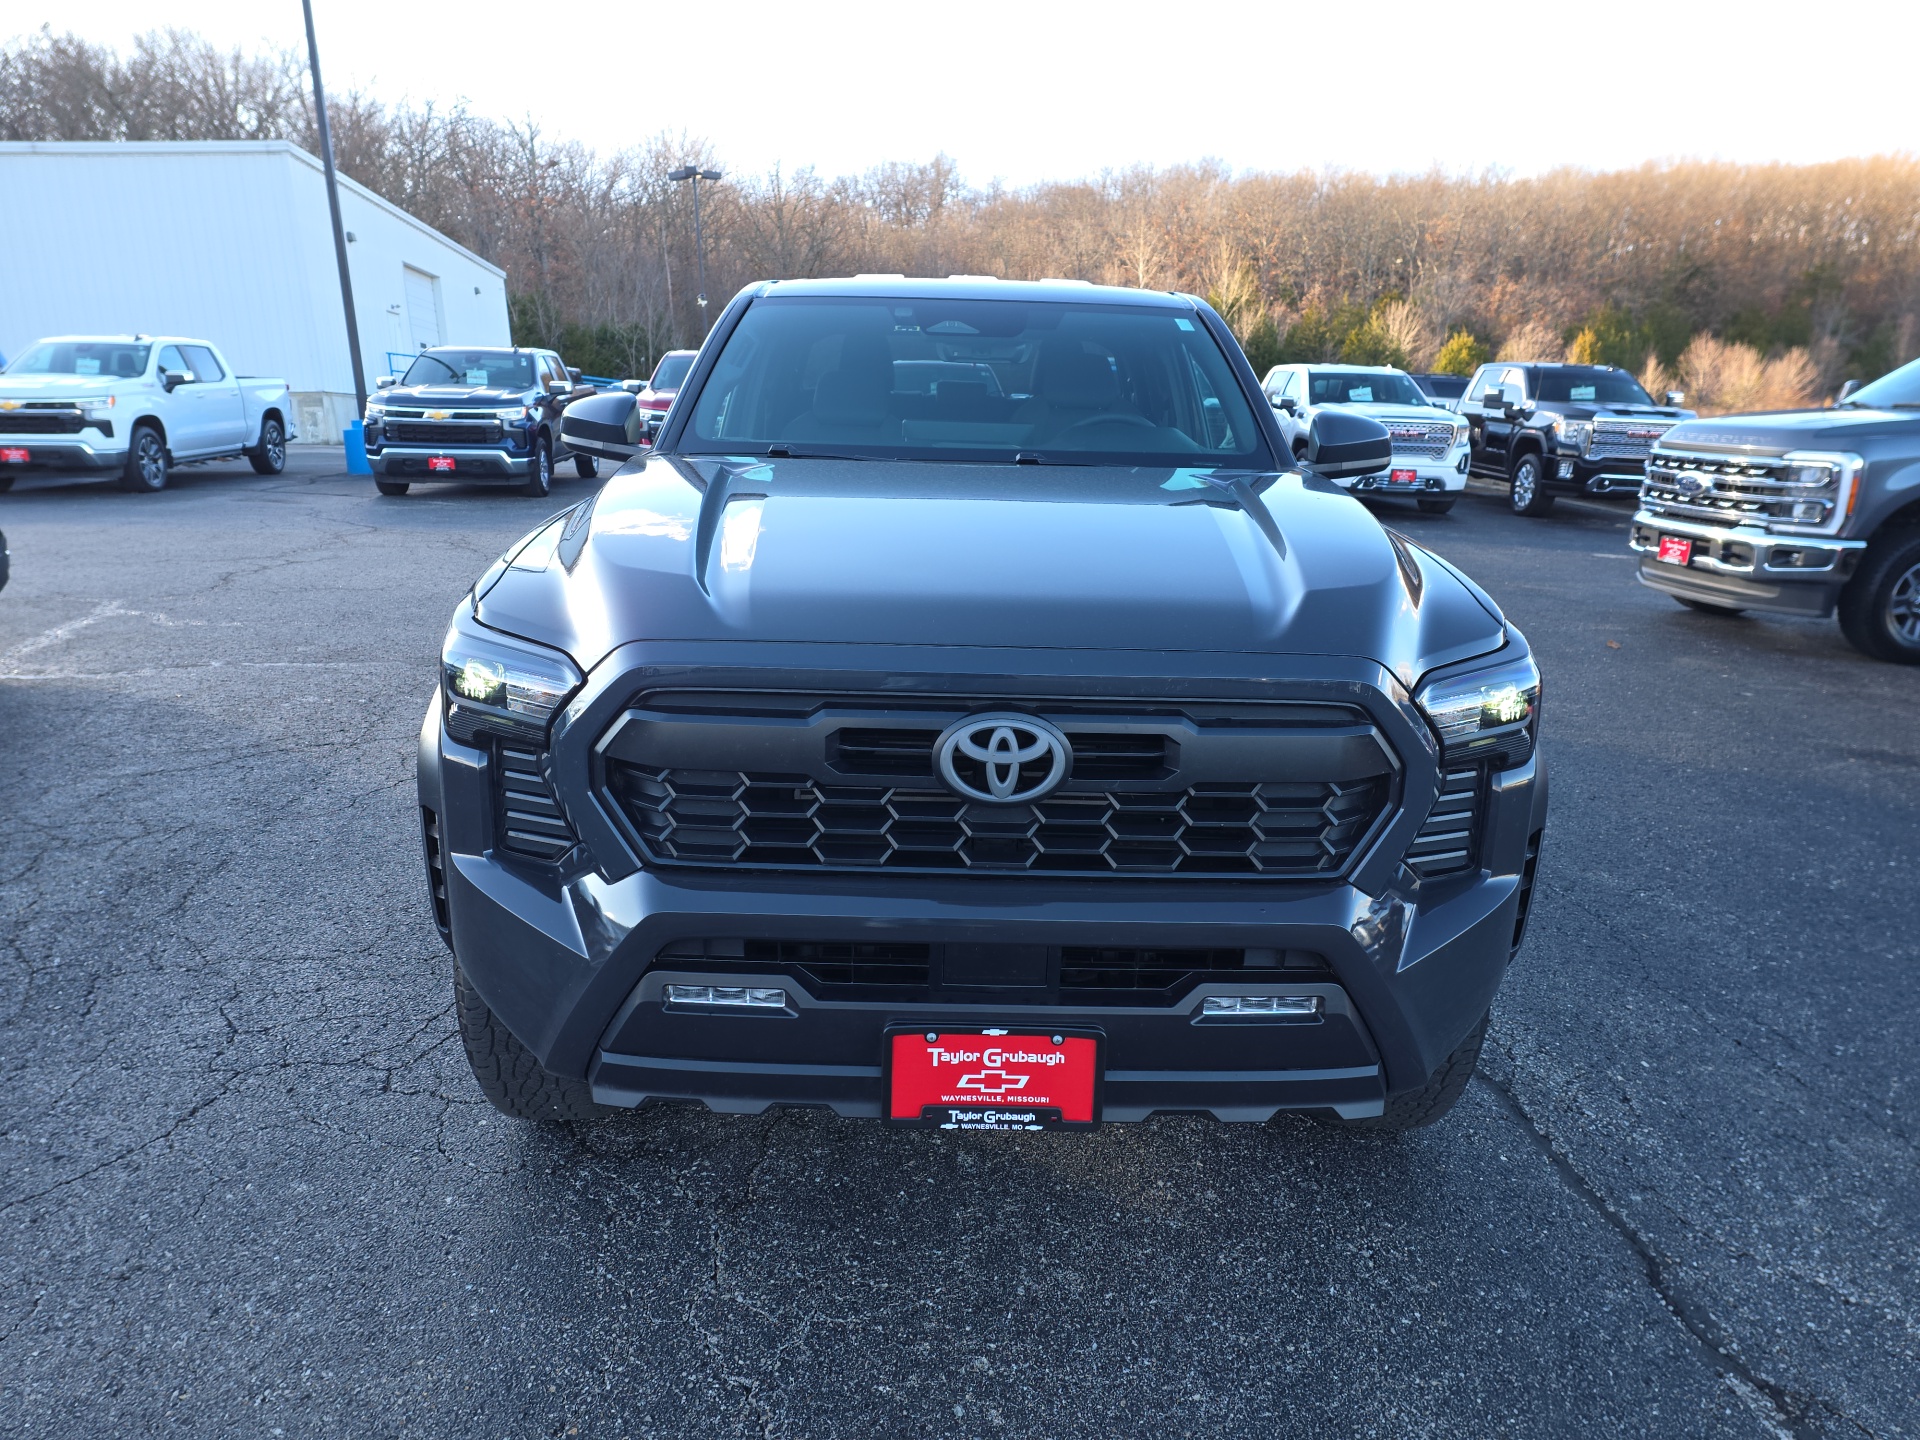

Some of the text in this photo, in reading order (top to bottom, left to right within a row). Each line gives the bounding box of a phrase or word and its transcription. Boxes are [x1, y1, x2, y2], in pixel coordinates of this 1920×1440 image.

[927, 1048, 1065, 1067] Taylor Grubaugh
[941, 1095, 1050, 1104] WAYNESVILLE, MISSOURI
[948, 1110, 1036, 1123] Taylor Grubaugh
